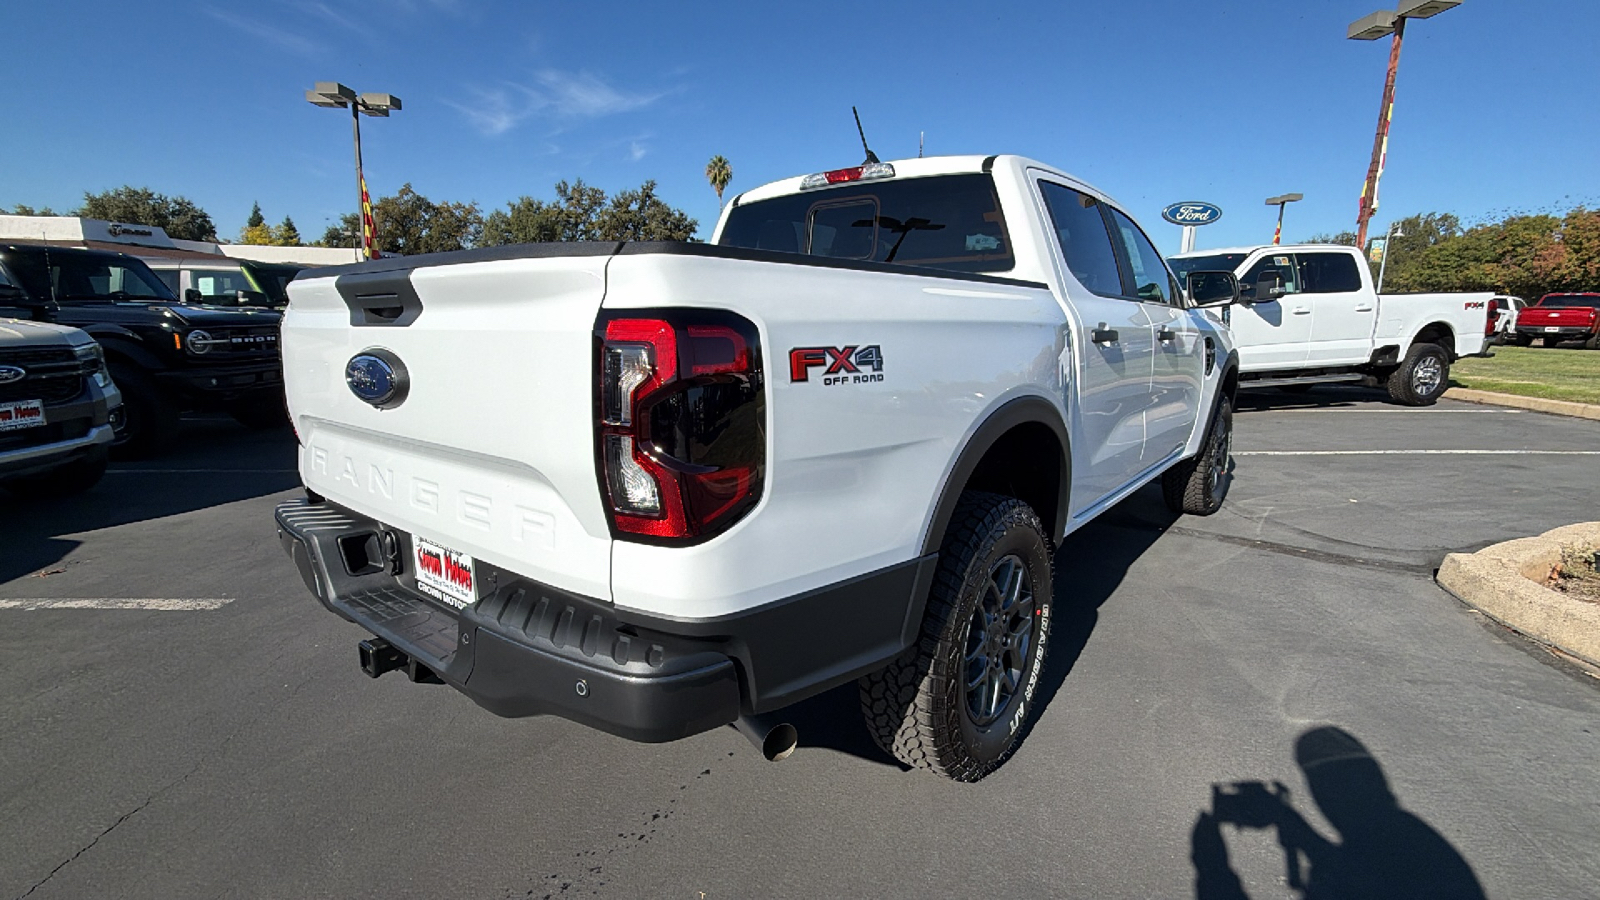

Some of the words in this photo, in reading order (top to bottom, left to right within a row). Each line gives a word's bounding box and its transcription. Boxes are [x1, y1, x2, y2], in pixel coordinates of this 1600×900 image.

[1176, 205, 1212, 221] Ford
[1464, 302, 1485, 310] FX4
[788, 344, 884, 383] FX4
[823, 376, 849, 386] OFF
[853, 373, 884, 384] ROAD
[311, 445, 556, 548] RANGER
[418, 546, 442, 578] Crown
[443, 549, 473, 592] Motors
[418, 582, 442, 600] CROWN
[1024, 604, 1049, 702] GRABBER
